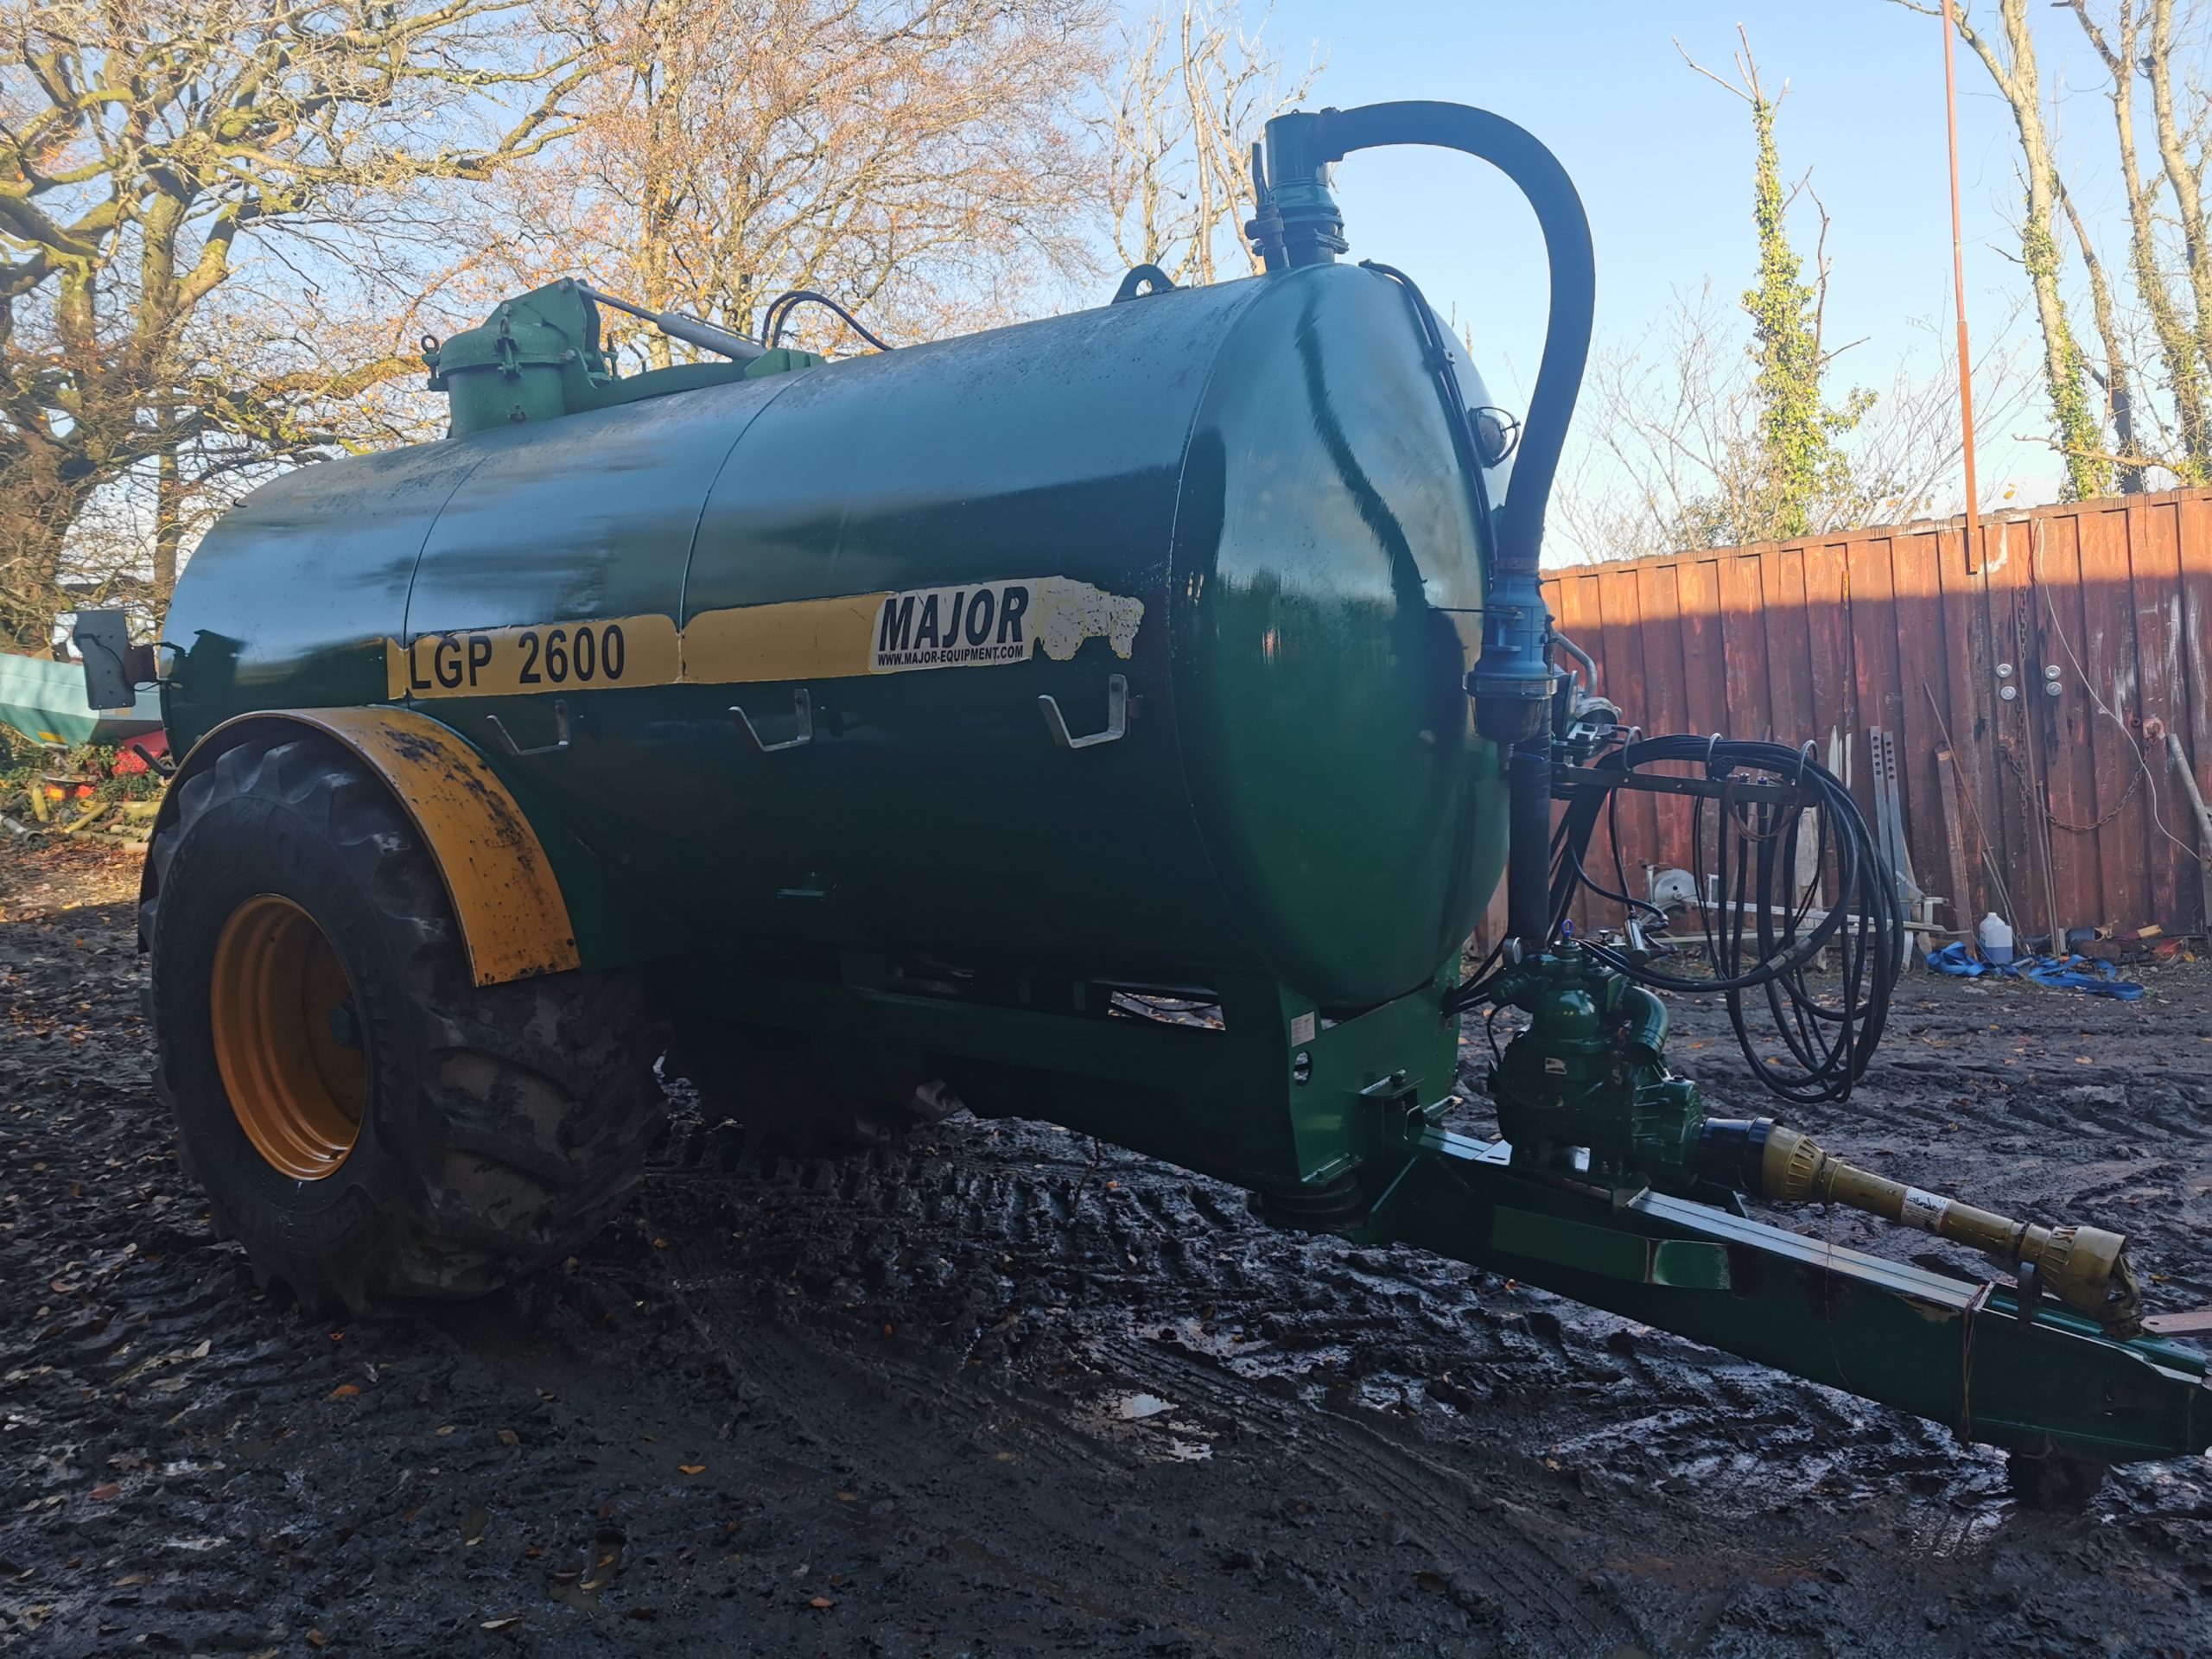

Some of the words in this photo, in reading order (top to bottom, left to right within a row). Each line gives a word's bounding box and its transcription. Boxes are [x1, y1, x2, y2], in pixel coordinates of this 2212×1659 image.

[879, 586, 1028, 652] MAJOR
[410, 635, 492, 690] LGP
[518, 625, 624, 683] 2600
[878, 645, 1023, 666] WWW.MAJOR-EQUIPMENT.COM
